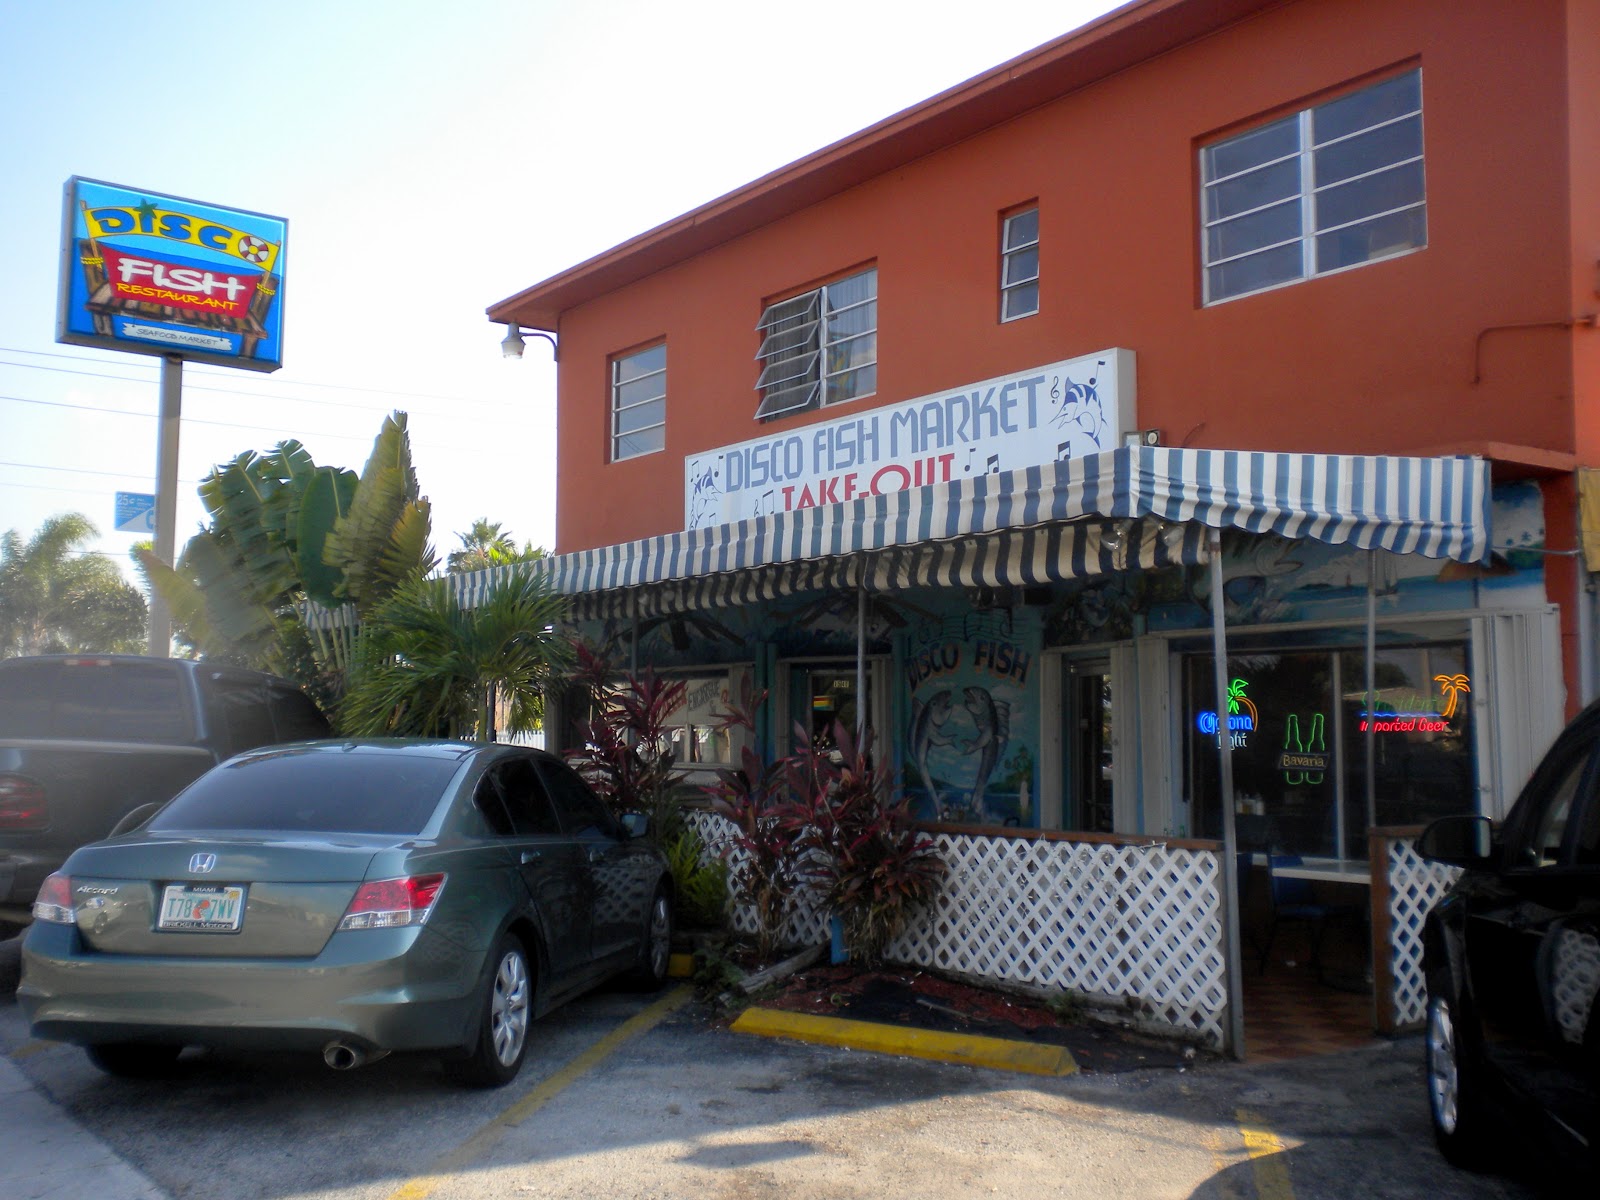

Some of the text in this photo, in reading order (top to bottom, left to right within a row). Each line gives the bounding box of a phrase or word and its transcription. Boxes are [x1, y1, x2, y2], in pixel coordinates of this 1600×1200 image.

[117, 257, 246, 301] FISH
[116, 282, 239, 311] RESTAURANT
[136, 328, 218, 346] SEAFOOD MARKET
[725, 375, 1046, 492] DISCO FISH MARKET
[974, 641, 1032, 688] FISH
[1418, 717, 1449, 732] Beer
[1283, 753, 1325, 767] Bavaria
[76, 885, 119, 895] Accord
